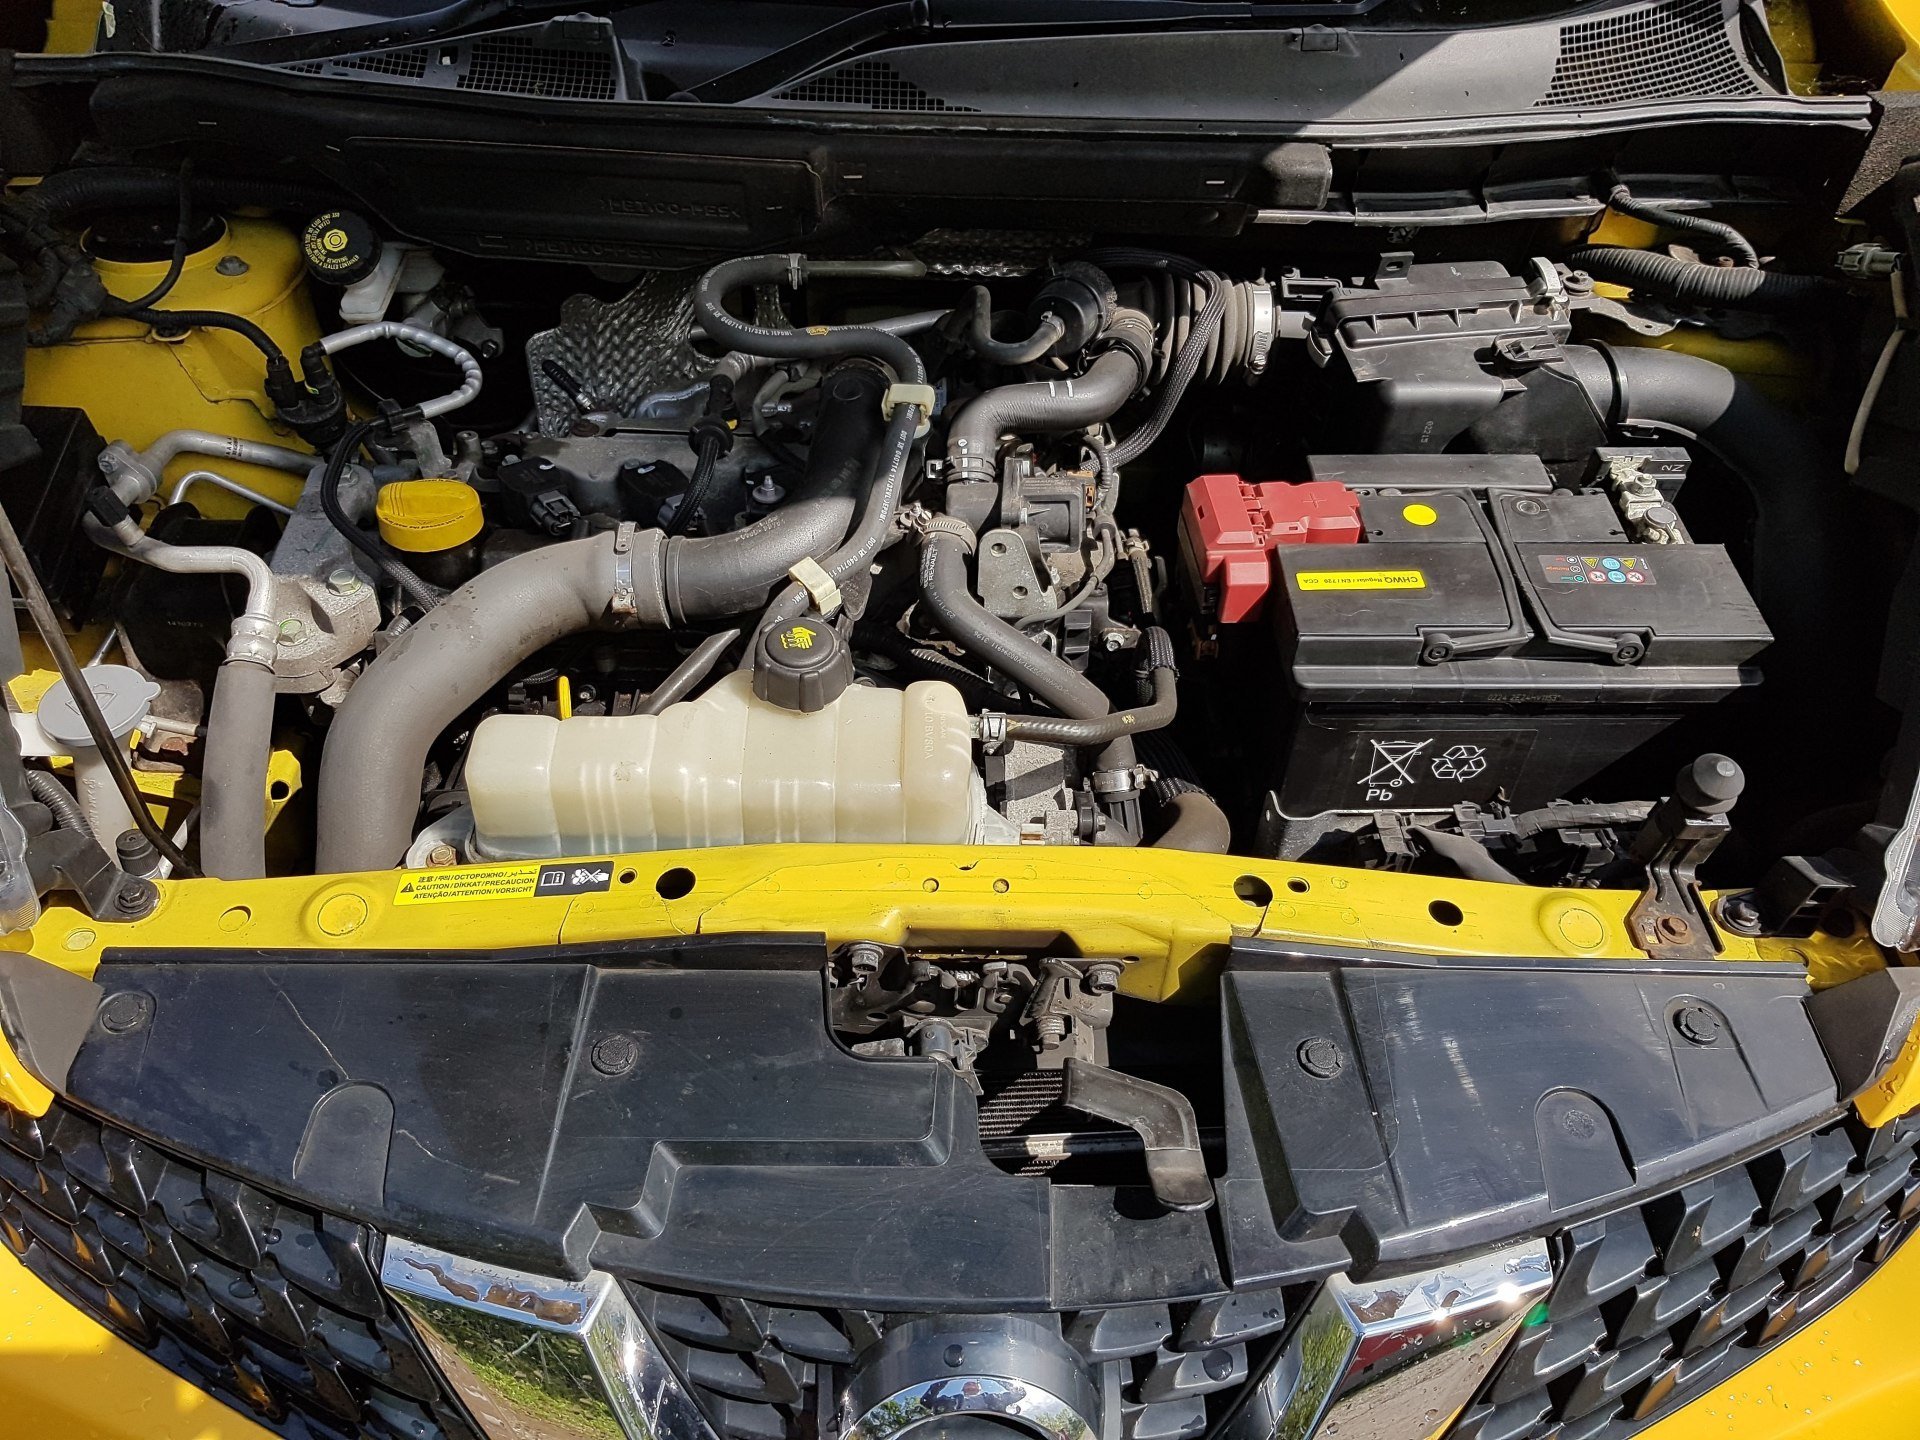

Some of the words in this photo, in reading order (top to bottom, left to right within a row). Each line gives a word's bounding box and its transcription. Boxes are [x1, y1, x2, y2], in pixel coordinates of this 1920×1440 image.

[836, 553, 859, 574] 040714
[929, 549, 938, 580] RENAULT
[1366, 789, 1392, 801] Pb
